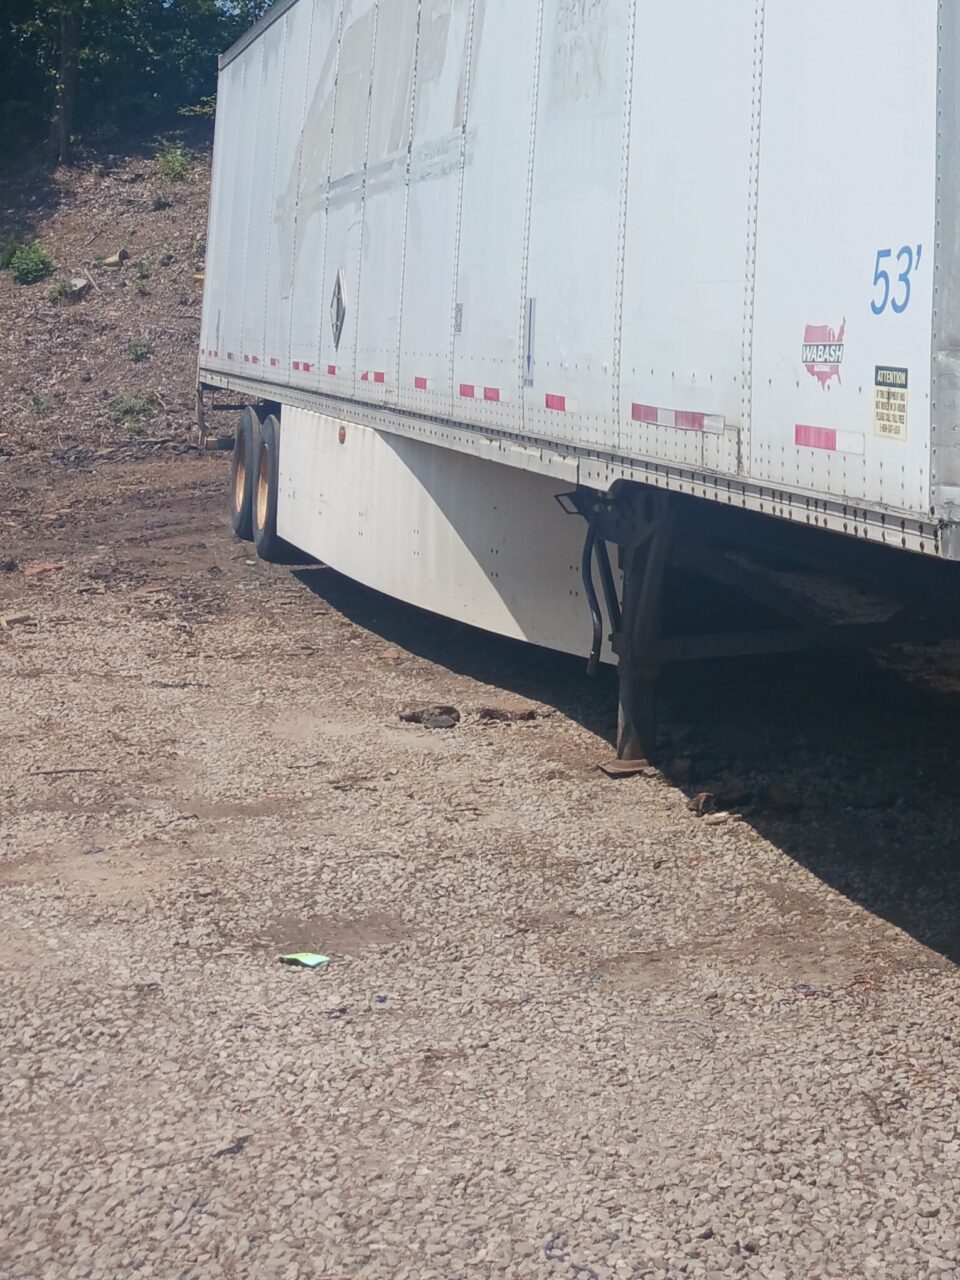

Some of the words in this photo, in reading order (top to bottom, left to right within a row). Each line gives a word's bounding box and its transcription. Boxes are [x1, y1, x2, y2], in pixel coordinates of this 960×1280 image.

[870, 244, 923, 315] 53'
[801, 344, 843, 363] WABASH
[877, 370, 906, 384] ATTENTION
